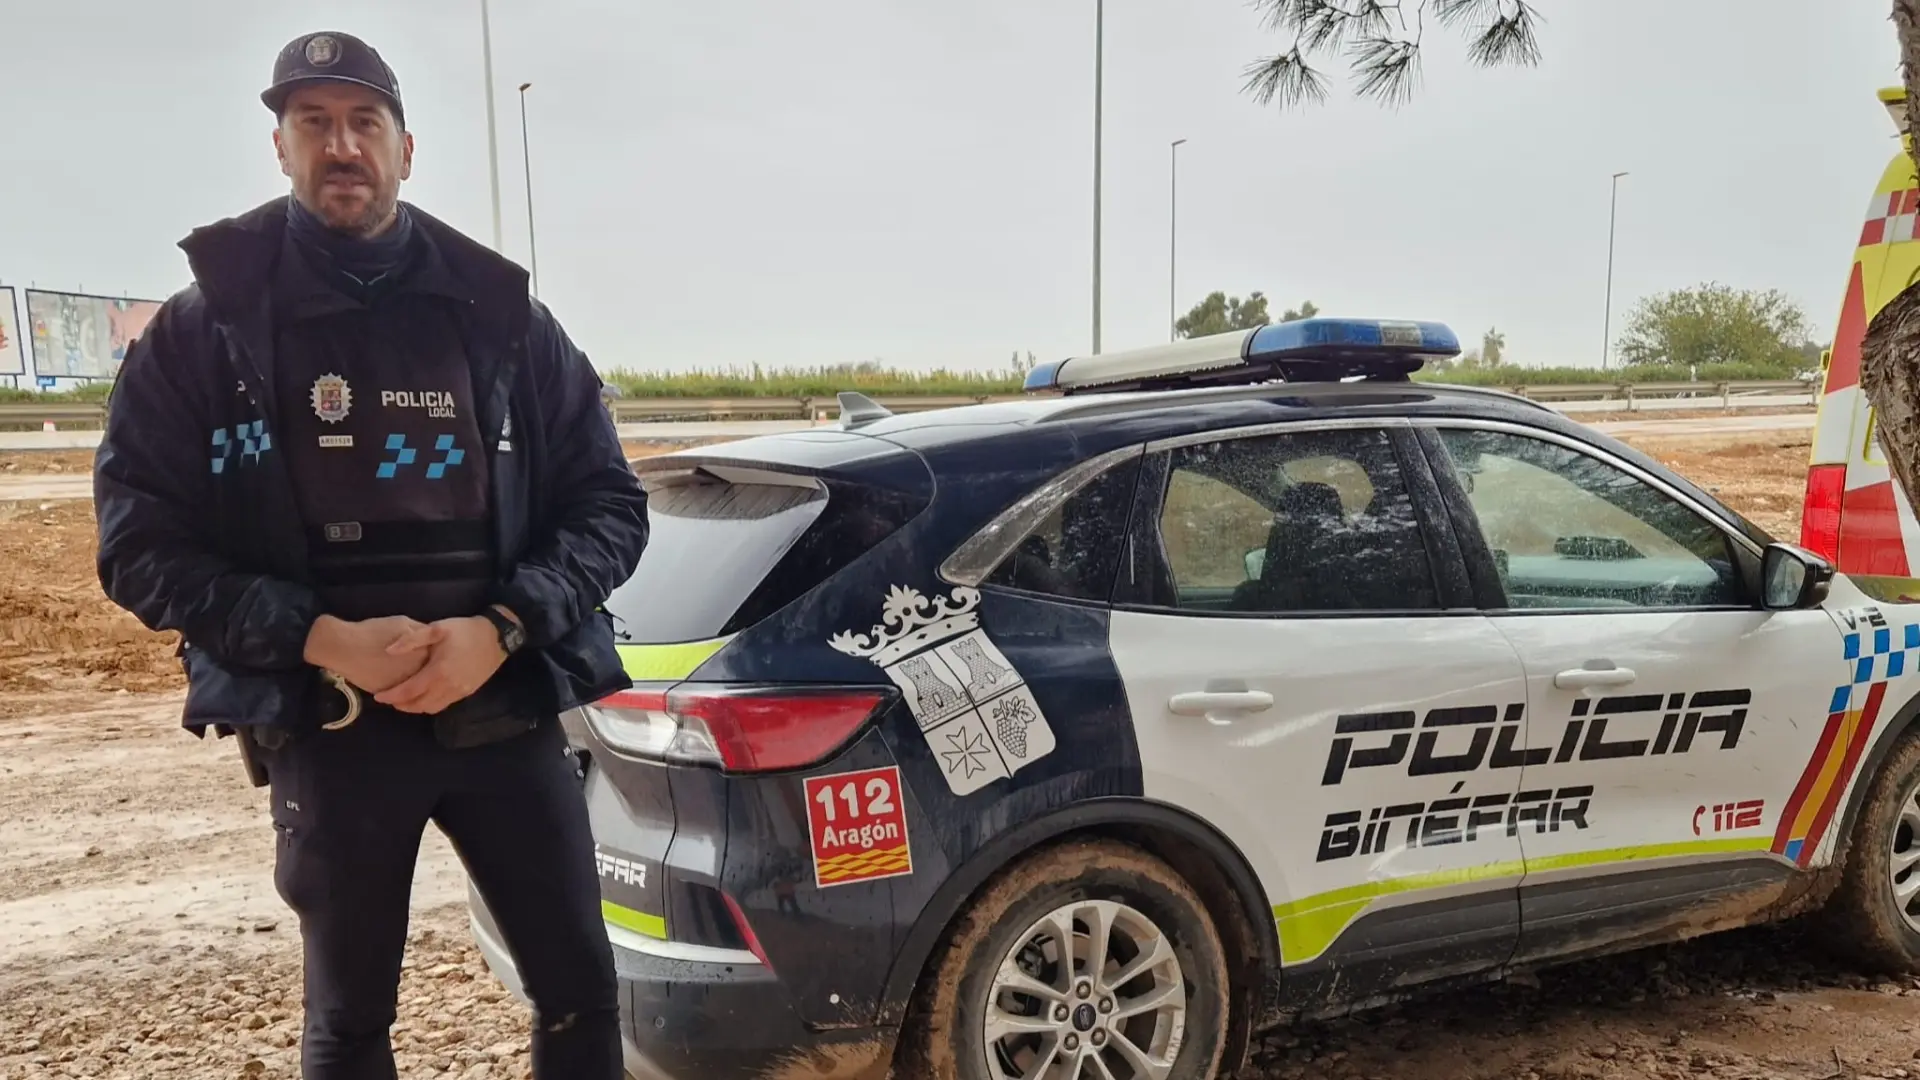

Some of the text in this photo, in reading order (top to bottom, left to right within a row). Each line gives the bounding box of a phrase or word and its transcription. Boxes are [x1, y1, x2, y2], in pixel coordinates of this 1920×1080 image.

[381, 390, 455, 408] POLICIA
[428, 407, 456, 418] LOCAL
[1321, 688, 1752, 786] POLICIA
[816, 777, 895, 821] 112
[1712, 799, 1765, 831] 112
[822, 818, 899, 848] Aragón
[1316, 781, 1594, 863] BINÉFAR
